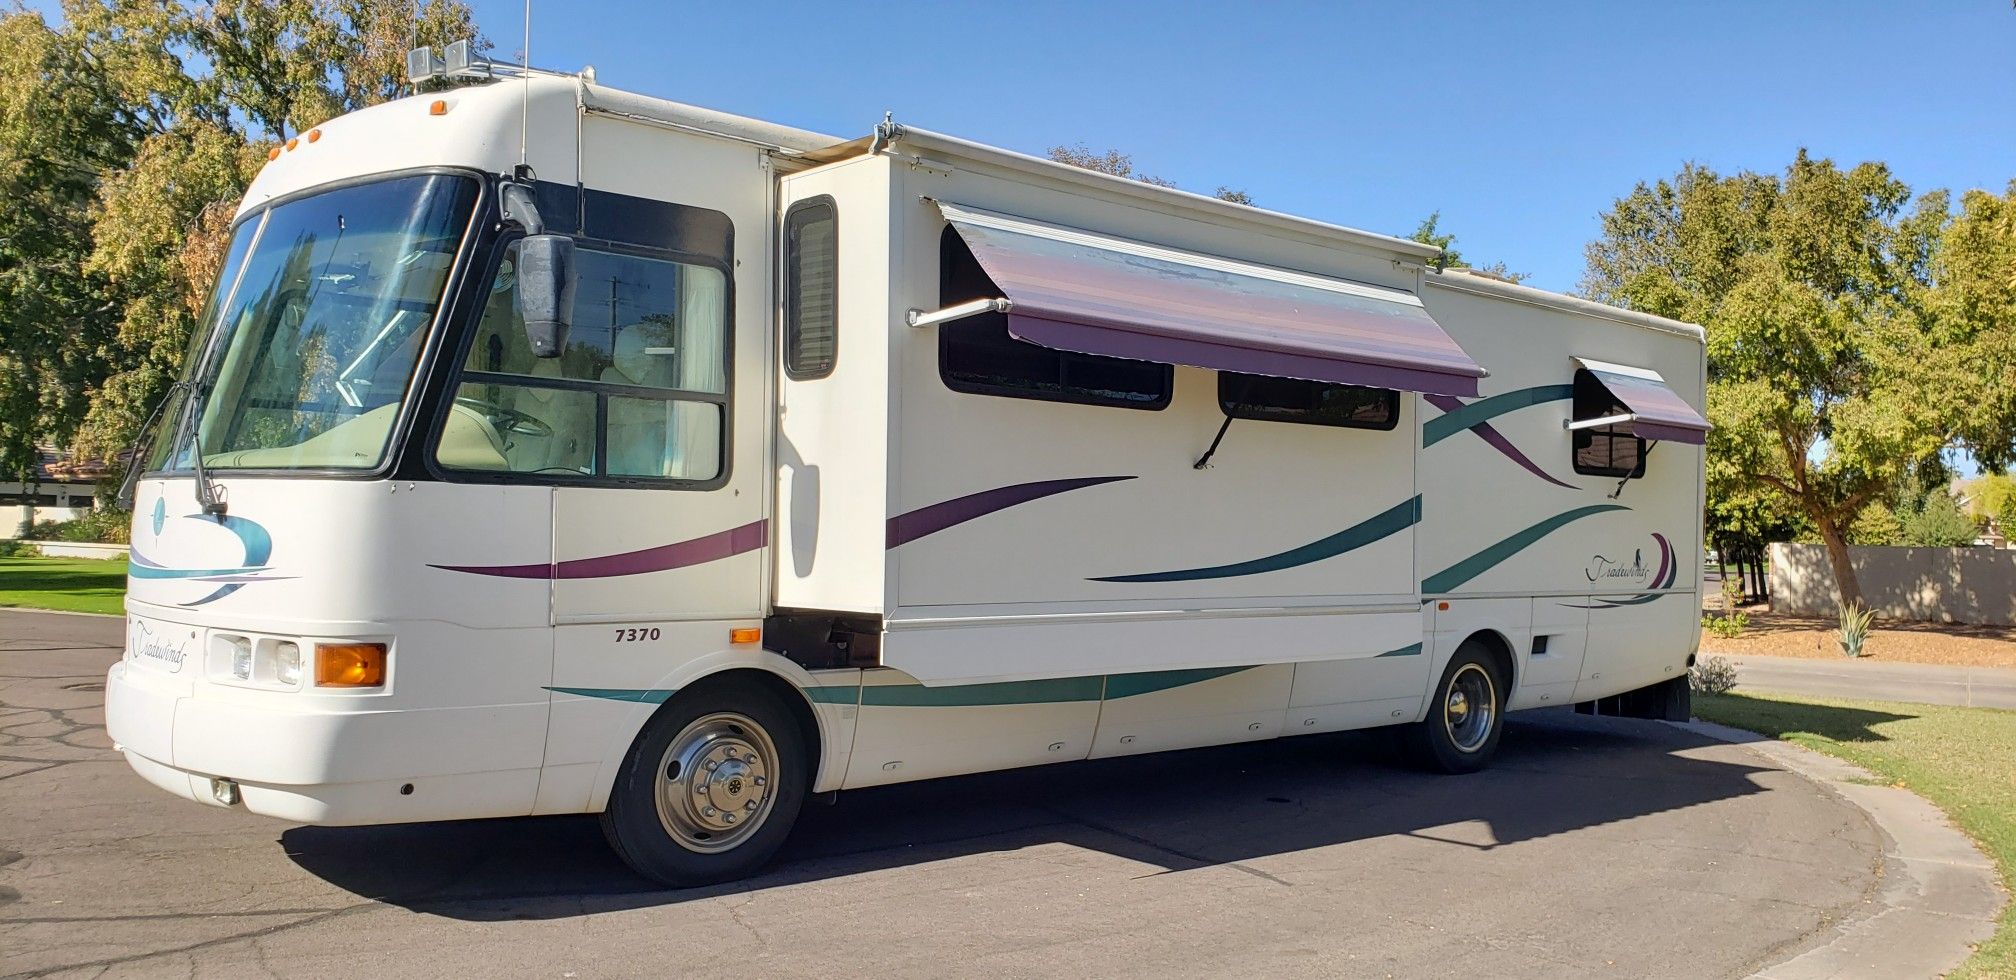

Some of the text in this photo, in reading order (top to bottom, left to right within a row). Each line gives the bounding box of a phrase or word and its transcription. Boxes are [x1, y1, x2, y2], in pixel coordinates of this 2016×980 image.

[1585, 554, 1650, 584] Tradewinds
[132, 619, 188, 674] Tradewinds
[615, 627, 661, 643] 7370
